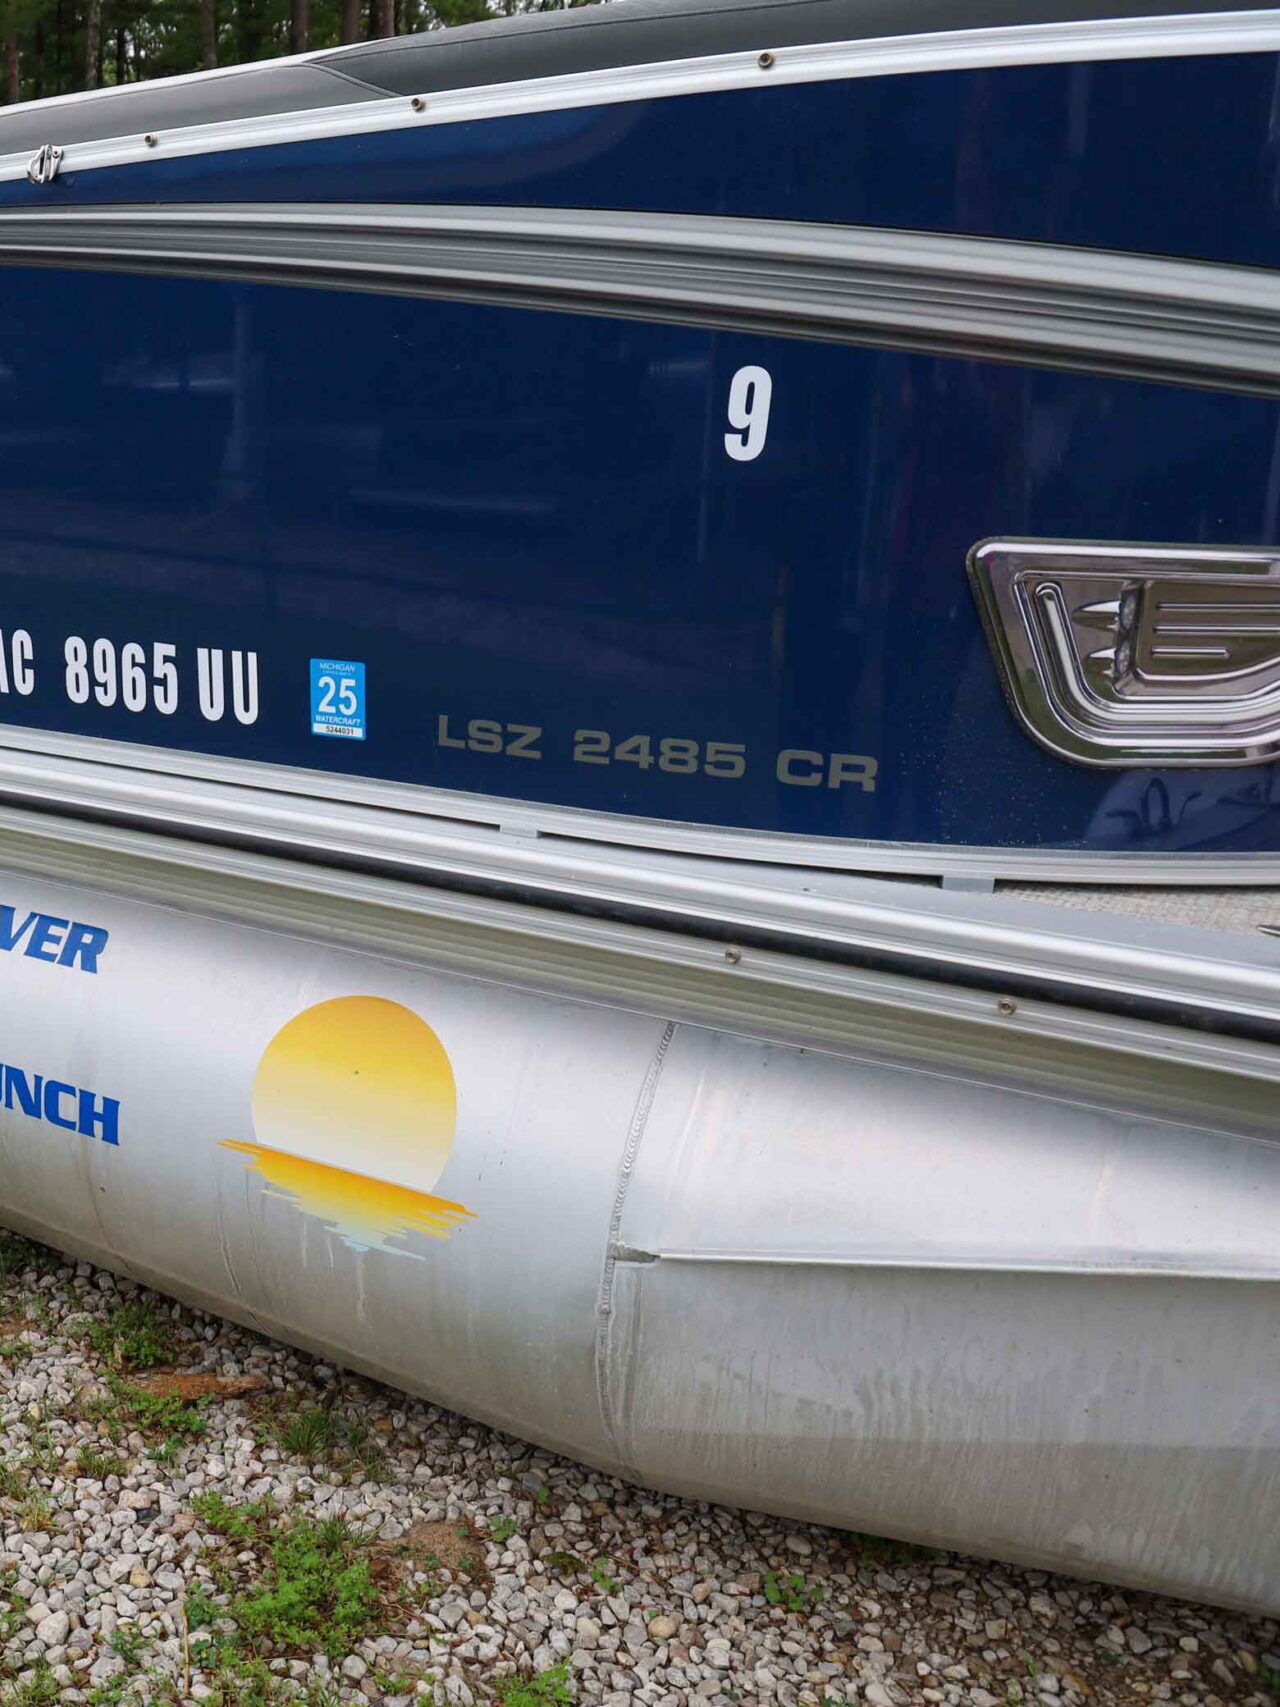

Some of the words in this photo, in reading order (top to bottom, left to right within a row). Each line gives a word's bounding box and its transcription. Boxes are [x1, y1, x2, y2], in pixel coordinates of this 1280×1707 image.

[724, 365, 773, 462] 9
[64, 635, 179, 715] 8965
[196, 647, 259, 725] UU
[318, 676, 357, 716] 25
[319, 662, 356, 672] MICHIGAN
[315, 716, 361, 727] WATERCRAFT
[437, 714, 542, 759] LSZ
[573, 729, 747, 778] 2485
[776, 749, 878, 792] CR
